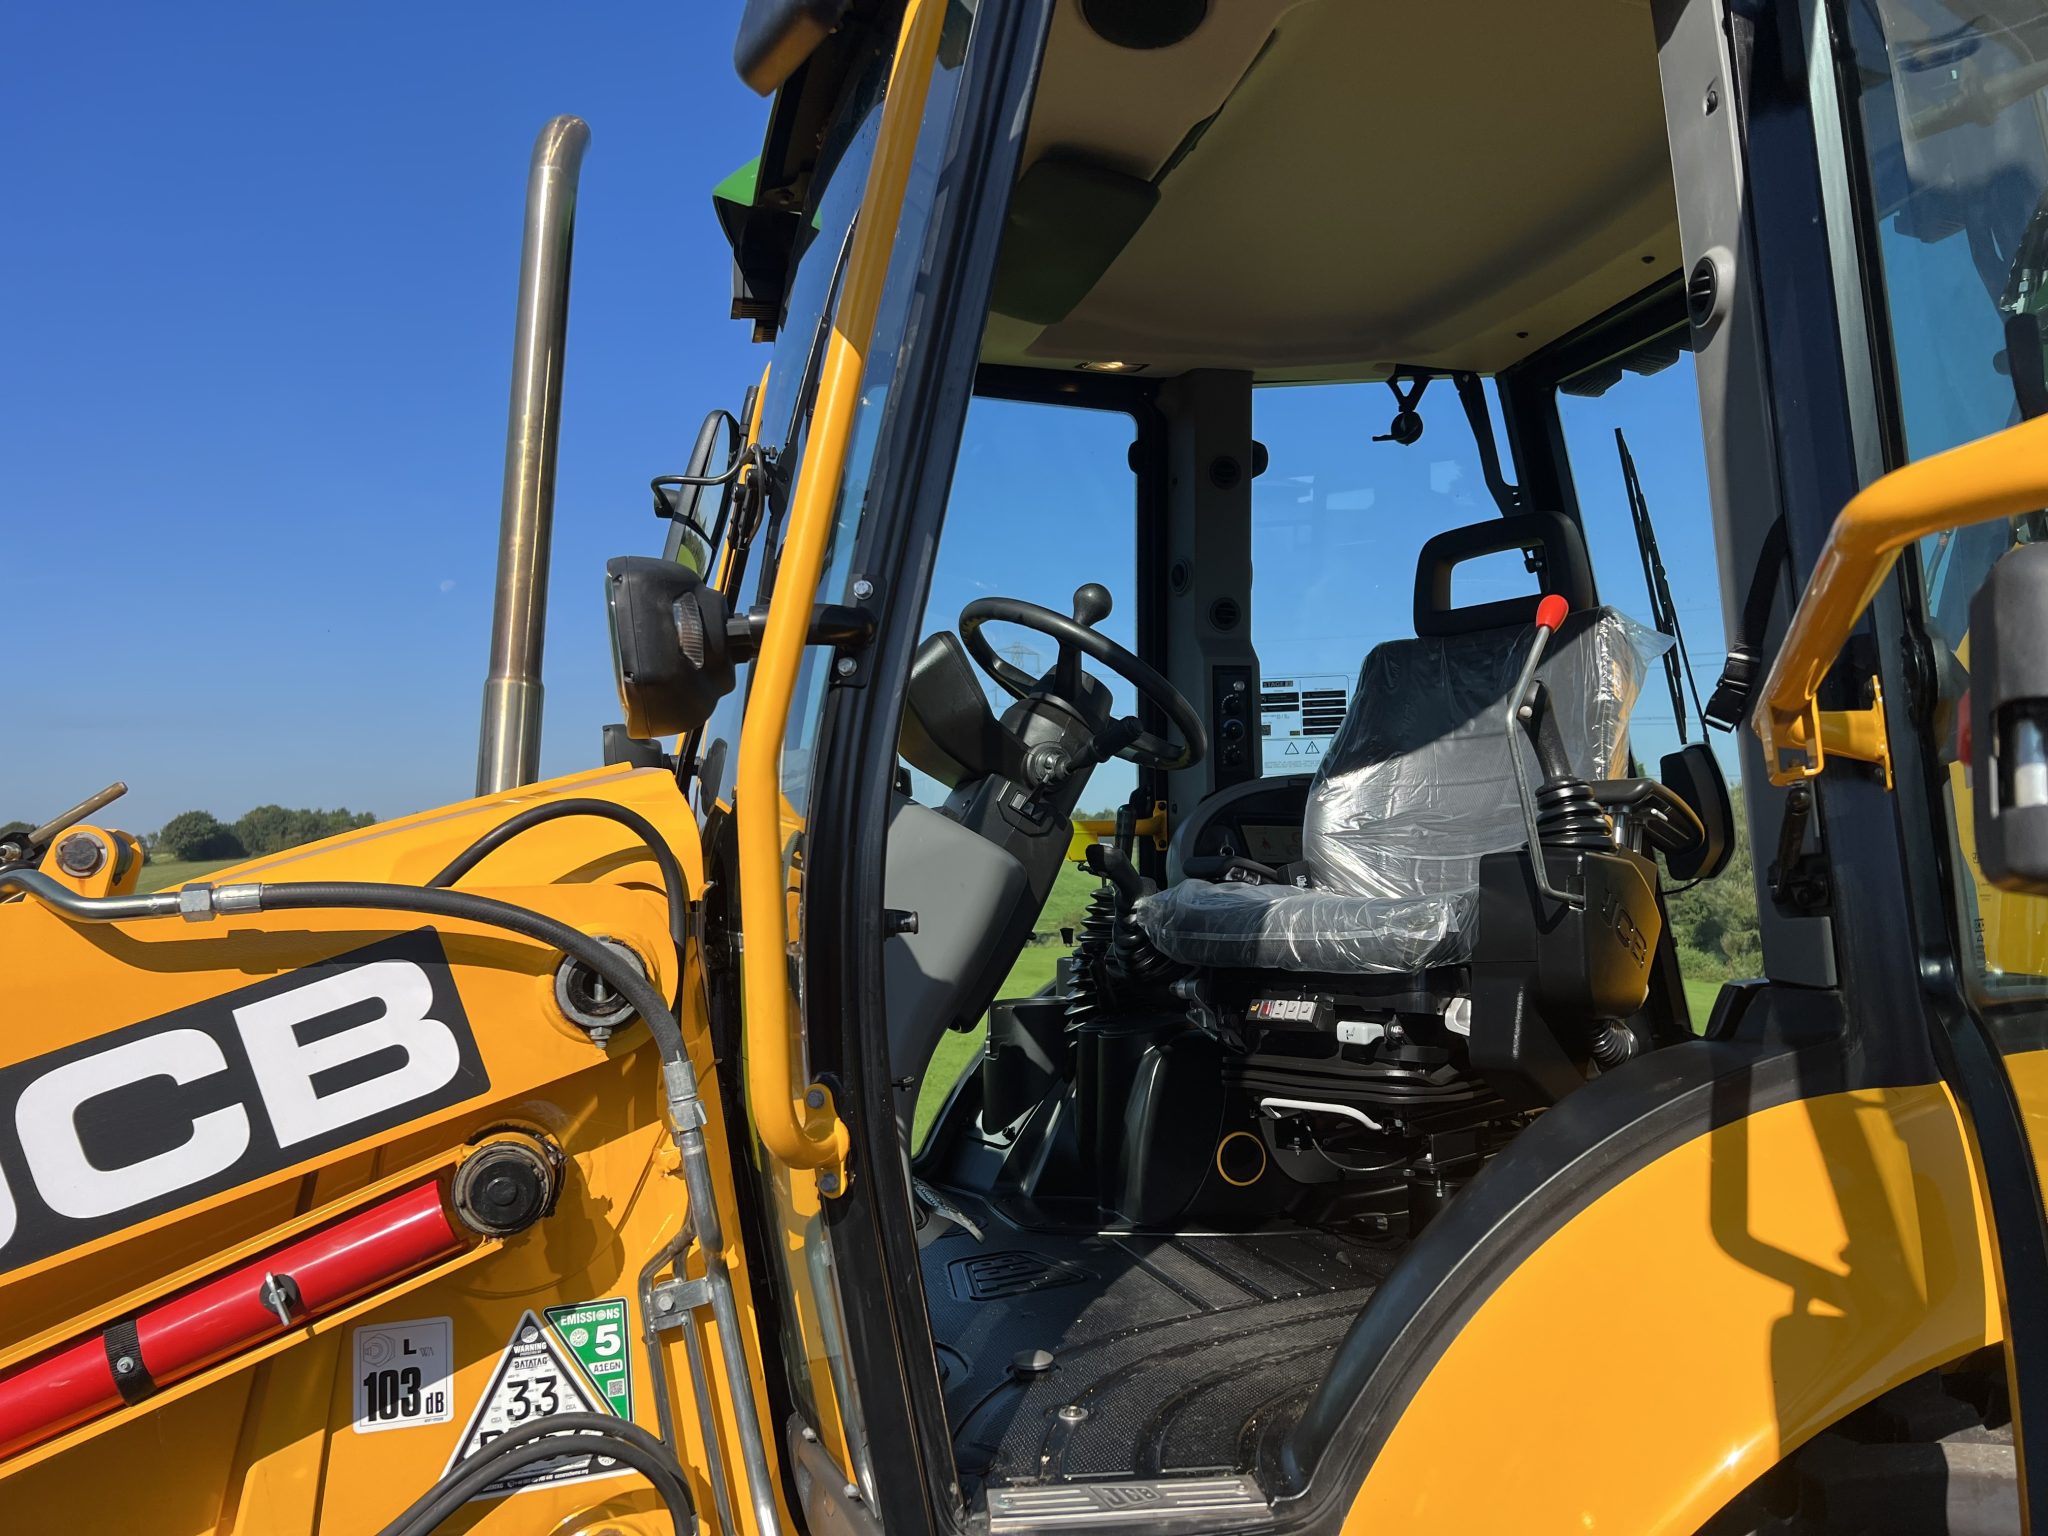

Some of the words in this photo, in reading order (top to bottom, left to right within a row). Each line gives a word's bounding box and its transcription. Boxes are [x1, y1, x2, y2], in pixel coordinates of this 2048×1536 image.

[0, 958, 460, 1251] CB
[560, 1308, 620, 1326] EMISSIONS
[403, 1339, 417, 1355] L
[513, 1342, 548, 1354] WARNING
[595, 1323, 621, 1356] 5
[593, 1361, 621, 1373] A1EGN
[363, 1367, 421, 1422] 103
[426, 1392, 444, 1414] dB
[507, 1375, 559, 1421] 33
